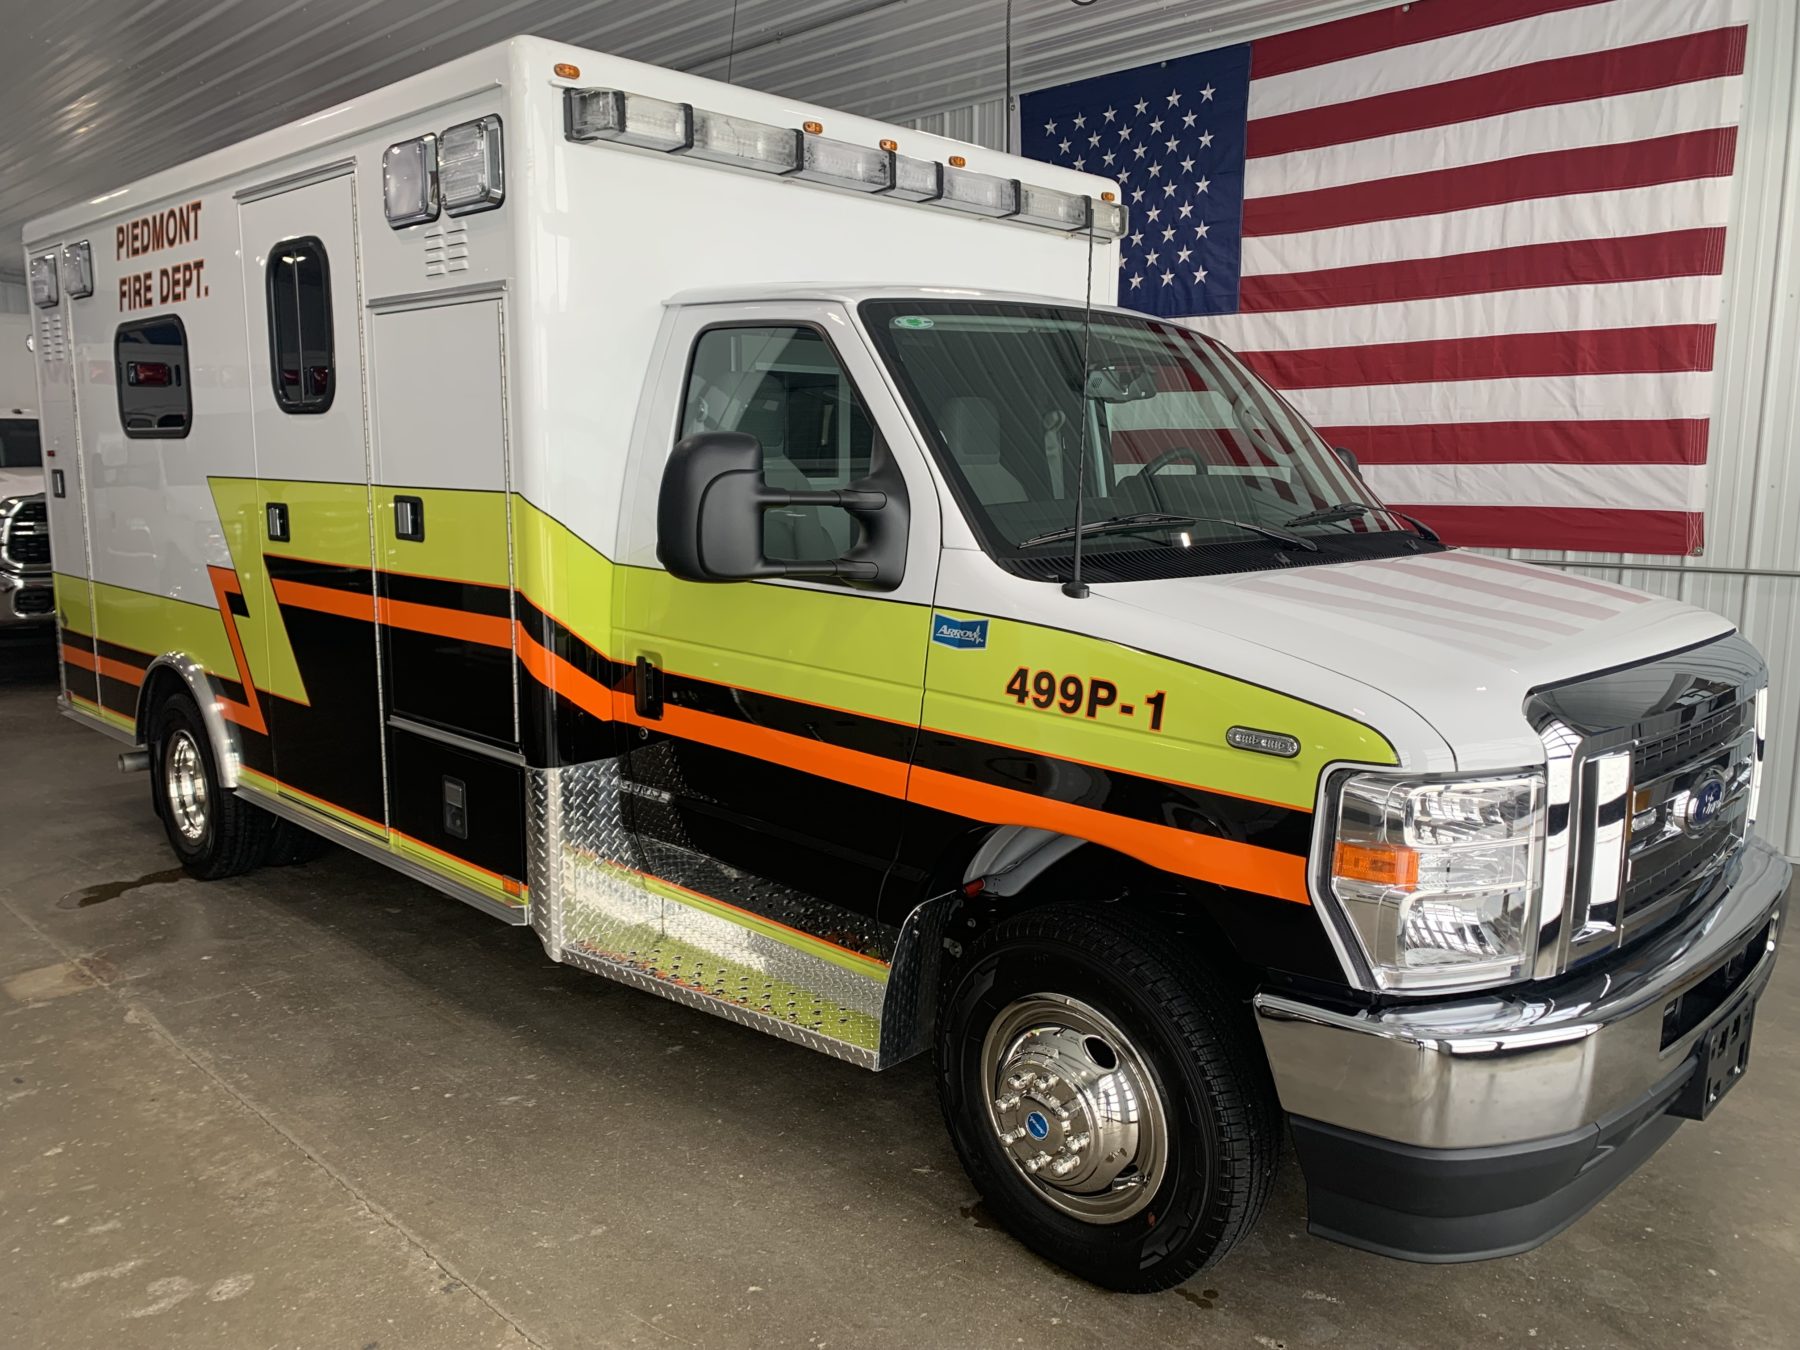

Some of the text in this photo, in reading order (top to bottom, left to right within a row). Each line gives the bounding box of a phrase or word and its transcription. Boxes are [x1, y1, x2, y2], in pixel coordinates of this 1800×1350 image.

[116, 200, 202, 261] PIEDMONT
[119, 259, 209, 312] FIRE DEPT.
[1005, 666, 1167, 733] 499P-1
